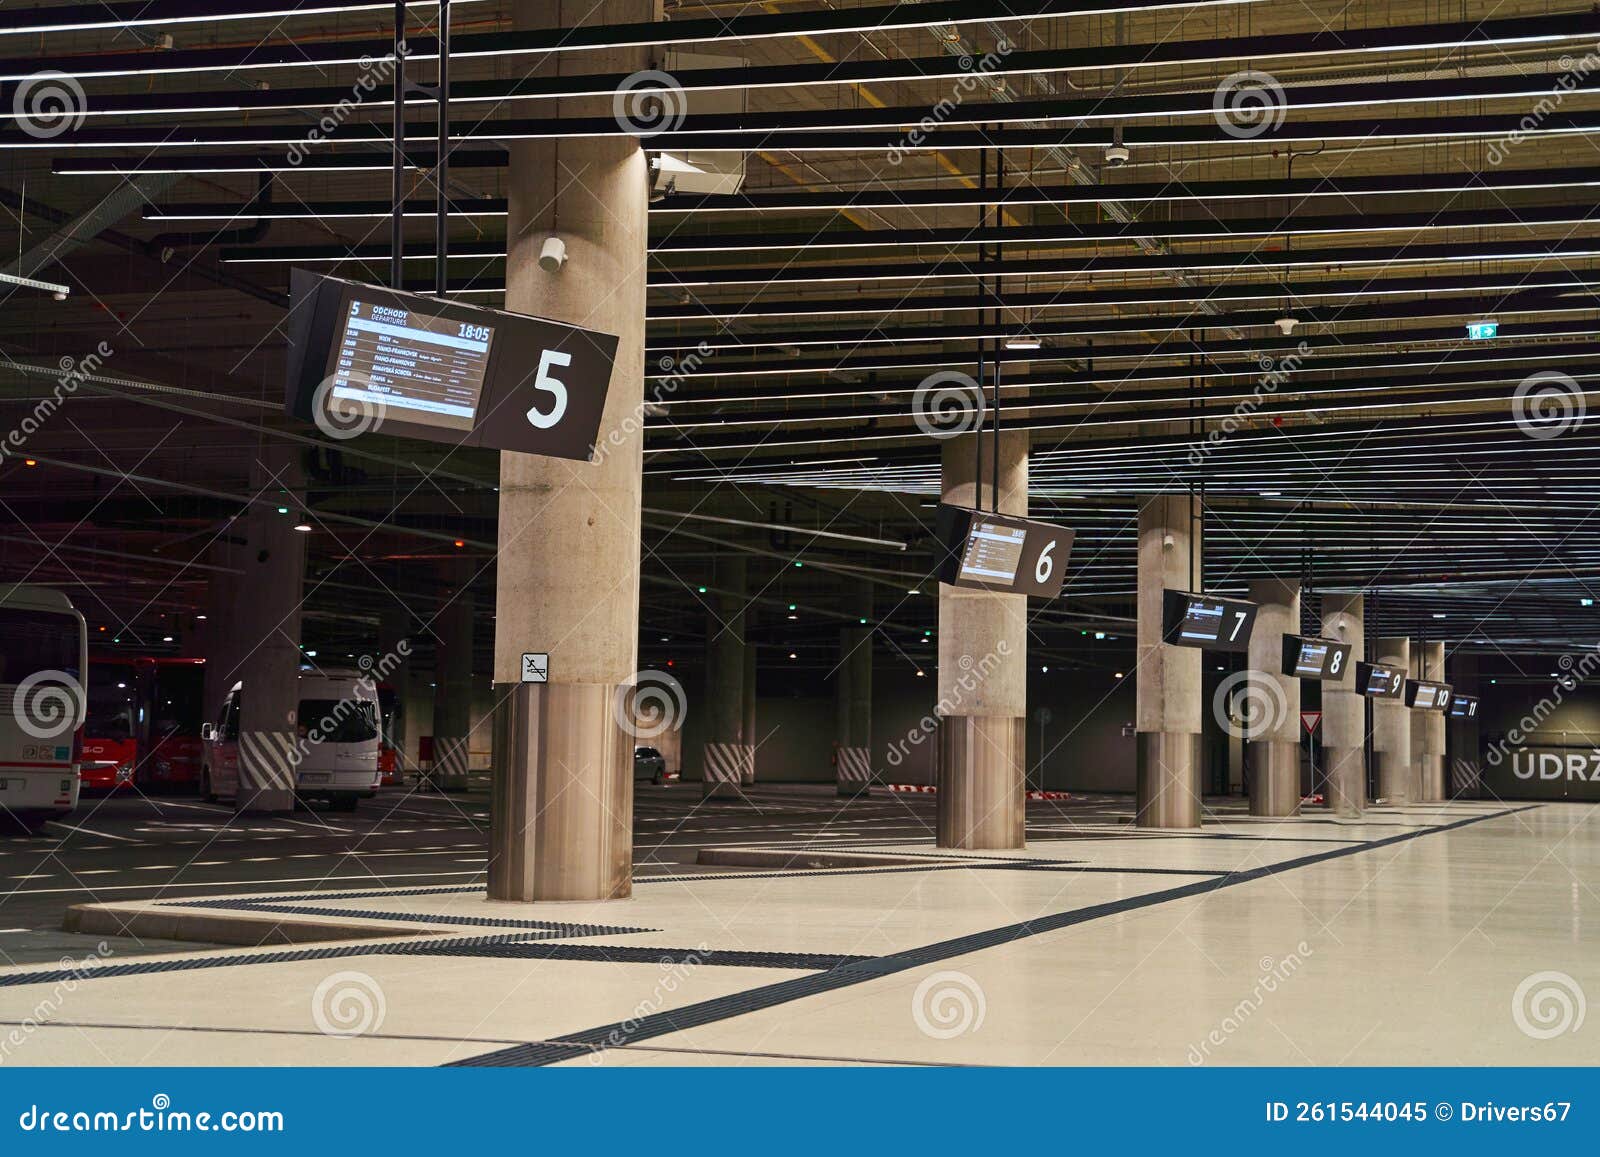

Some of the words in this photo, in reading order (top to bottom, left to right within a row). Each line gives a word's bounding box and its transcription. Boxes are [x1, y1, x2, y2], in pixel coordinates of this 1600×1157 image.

[351, 301, 360, 316] 5
[373, 306, 408, 318] ODCHODY
[371, 313, 407, 326] DEPARTURES
[458, 323, 490, 341] 18:05
[527, 350, 571, 429] 5
[1035, 540, 1056, 584] 6
[1230, 611, 1247, 642] 7
[1330, 650, 1342, 674] 8
[1391, 673, 1401, 694] 9
[1436, 689, 1449, 707] 10
[1468, 701, 1477, 717] 11
